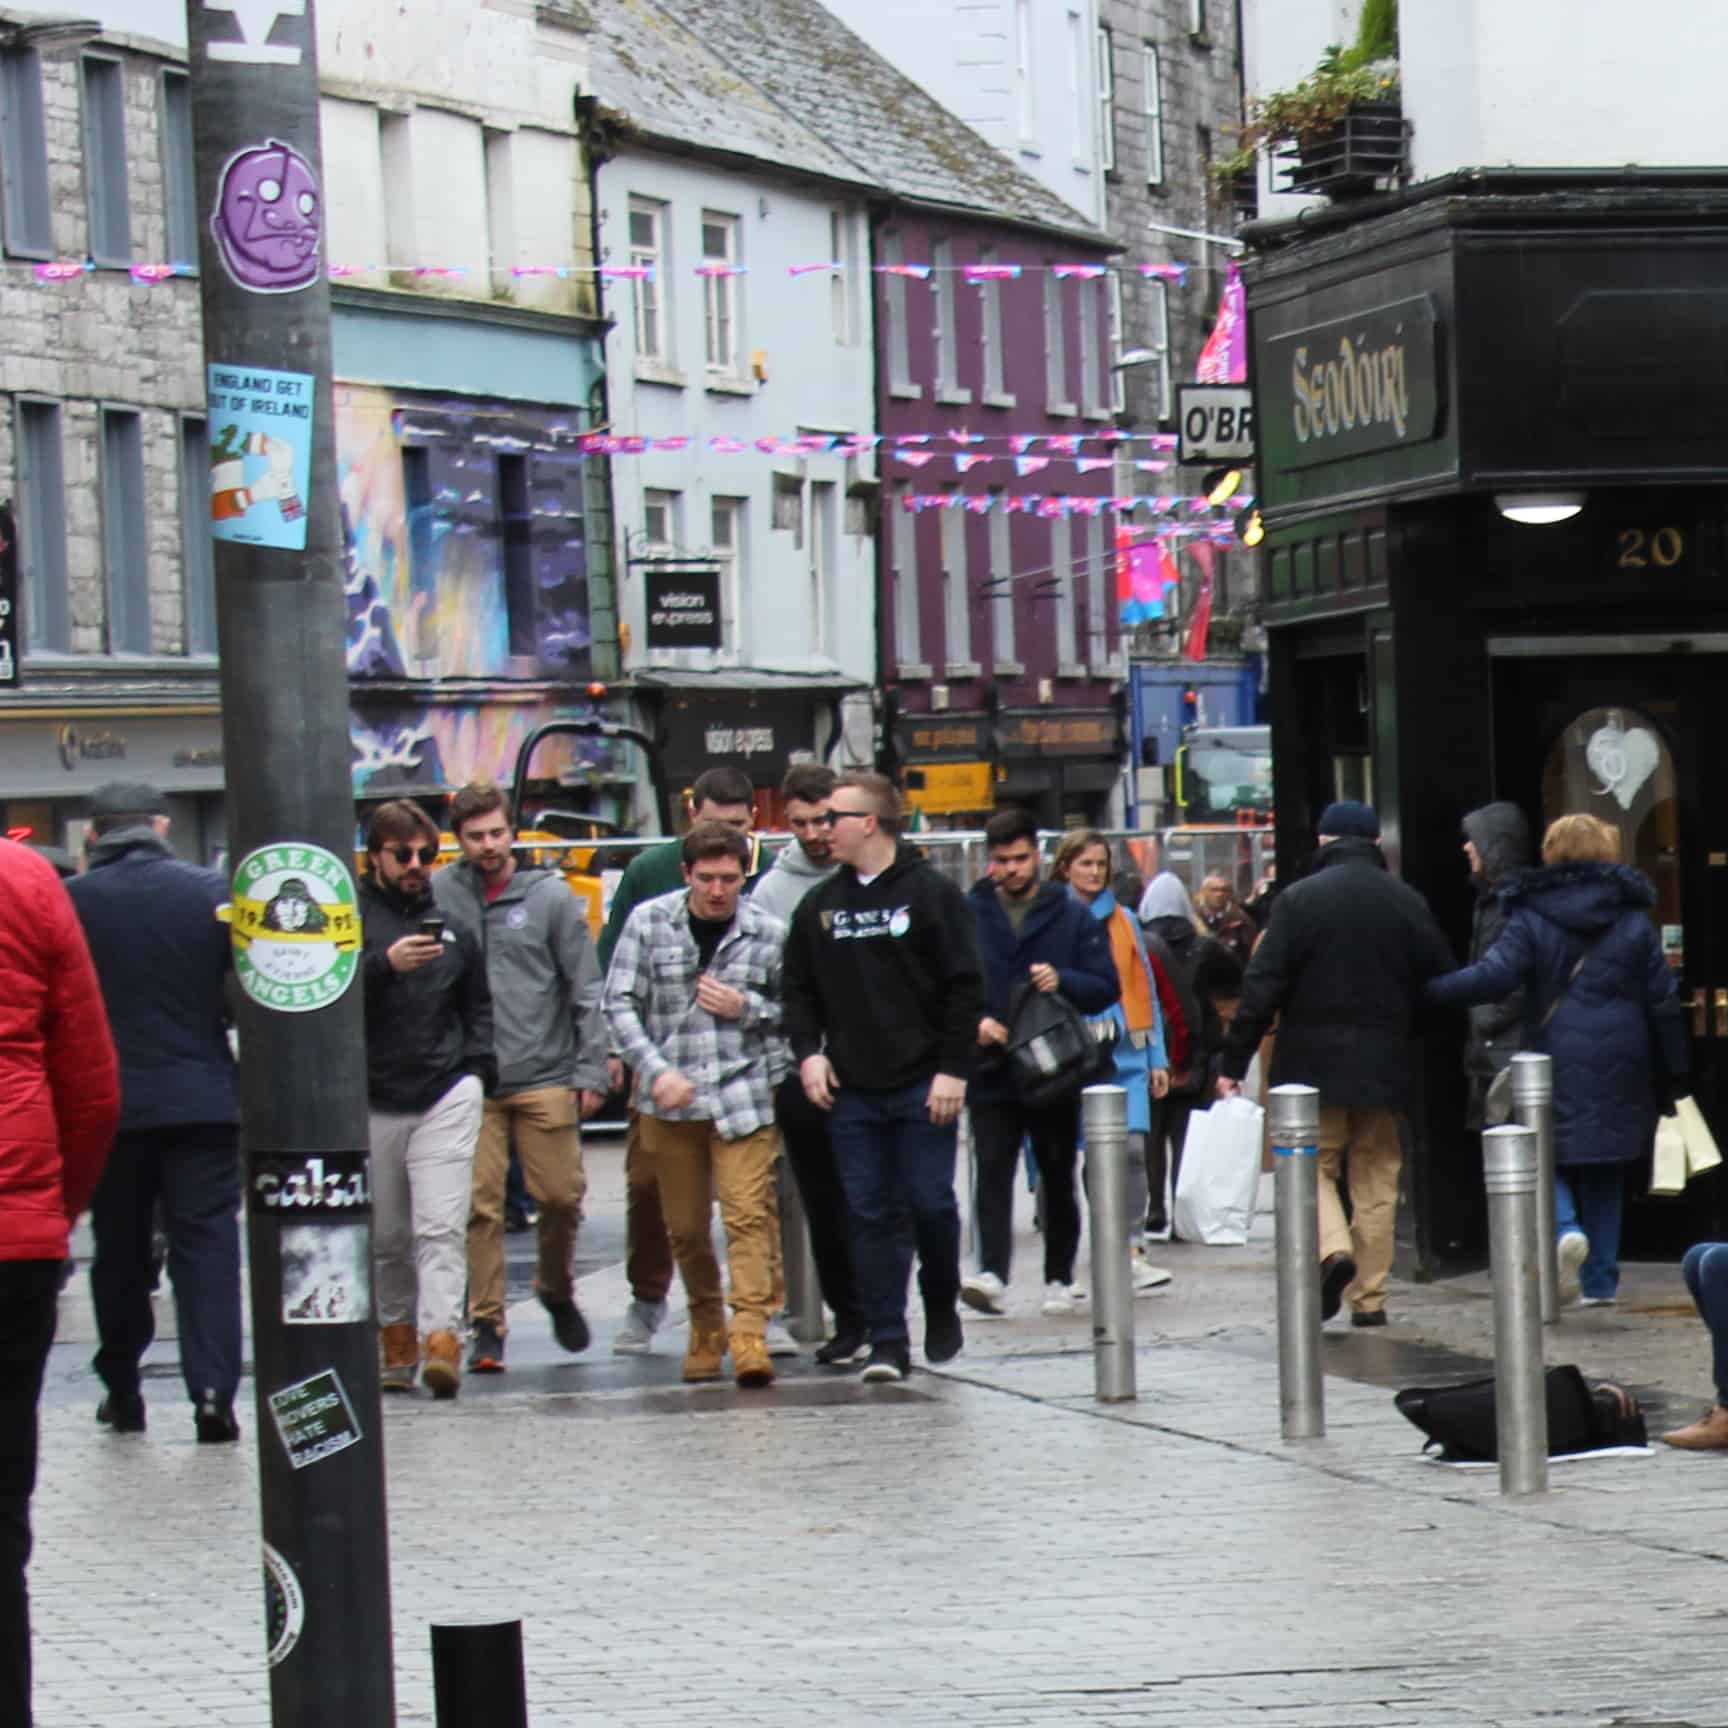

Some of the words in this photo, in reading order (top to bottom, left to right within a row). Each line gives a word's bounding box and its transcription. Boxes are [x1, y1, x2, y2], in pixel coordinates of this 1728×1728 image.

[212, 372, 271, 393] ENGLAND
[276, 380, 303, 396] GET
[231, 396, 248, 411] OF
[251, 399, 309, 419] IRELAND
[1617, 528, 1683, 568] 20
[244, 849, 346, 887] GREEN
[239, 970, 341, 1006] ANGELS
